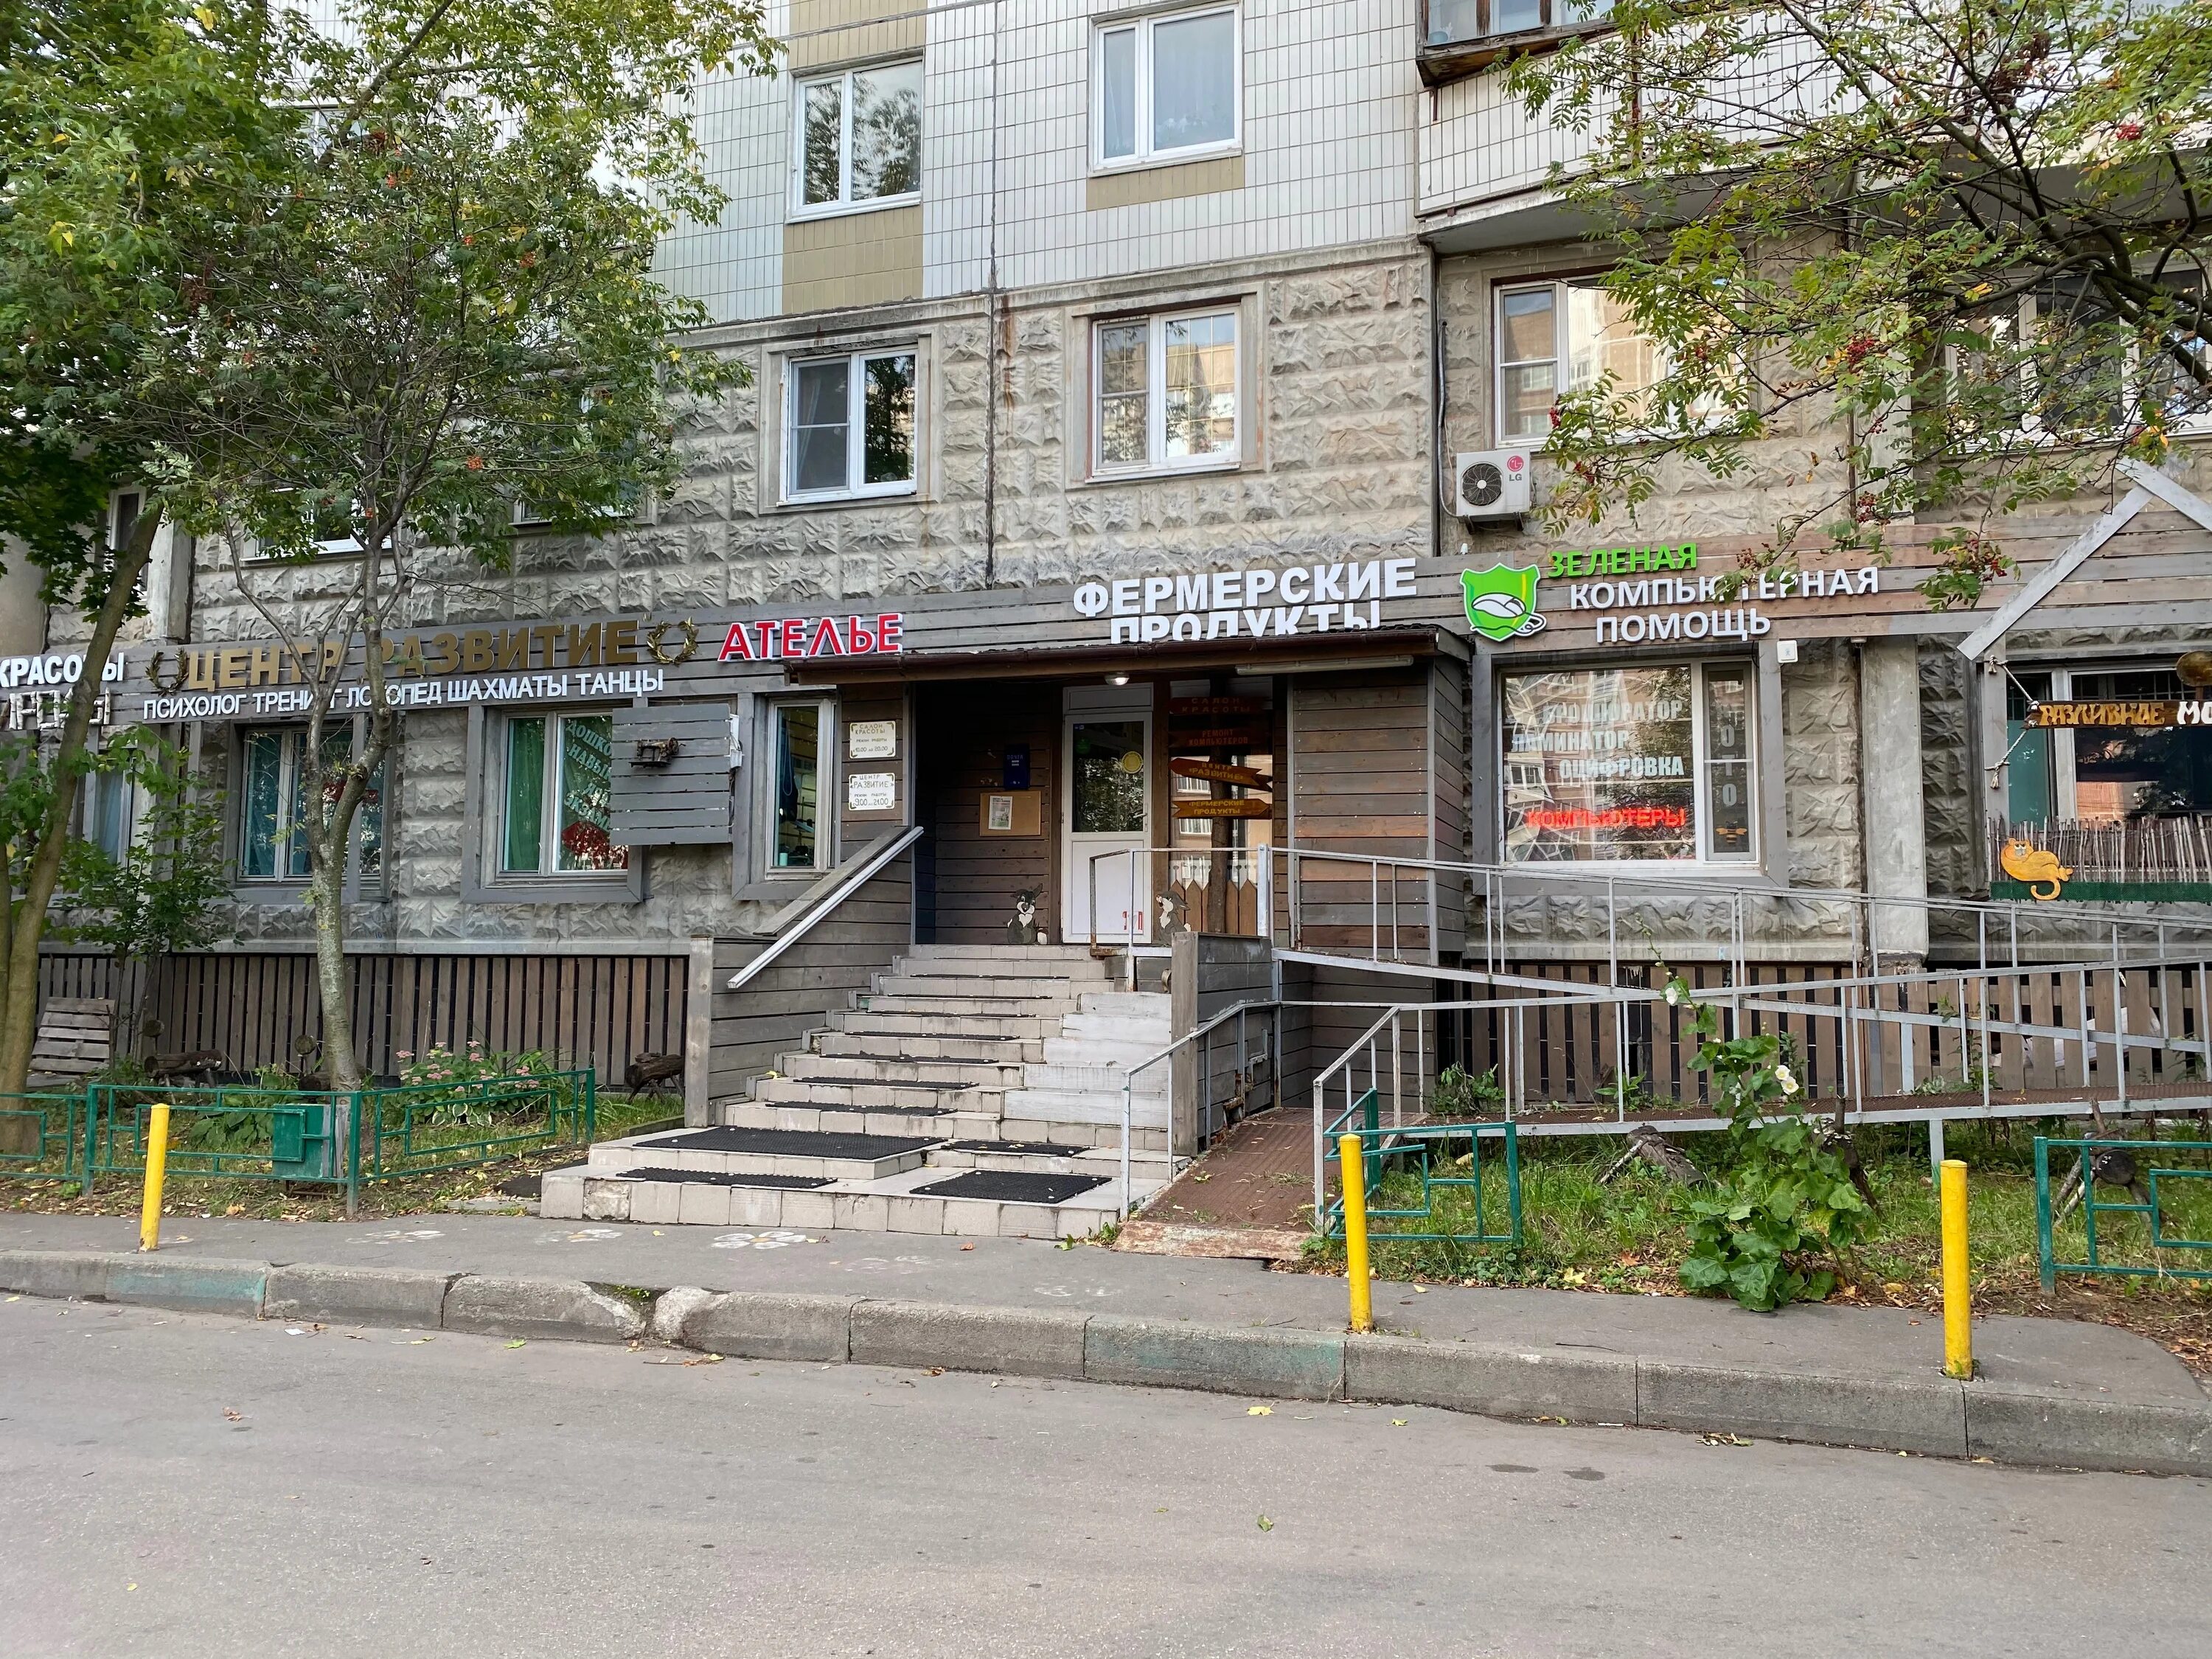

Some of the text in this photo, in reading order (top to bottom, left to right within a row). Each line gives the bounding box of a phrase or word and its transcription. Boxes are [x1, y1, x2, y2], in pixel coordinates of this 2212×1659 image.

[1509, 473, 1523, 481] LG
[1548, 543, 1697, 577] ЗЕЛЕНАЯ
[1073, 557, 1417, 618] ФЕРМЕРСКИЕ
[717, 613, 903, 662] АТЕЛЬЕ
[1596, 608, 1770, 643] ПОМОЩЬ
[0, 652, 125, 688] КРАСОЫ
[143, 669, 664, 720] ПСИХОЛОГ ТРЕНИГ ЛООПЕД ШАХМАТЫ ТАНЦЫ
[2039, 702, 2166, 726] РАЗЛИВНОЕ
[1512, 730, 1630, 753] ЛАМИНАТОР
[1559, 756, 1685, 779] ОЦИФРОВКА
[1527, 807, 1686, 828] КОМПЬЮТЕРЫ
